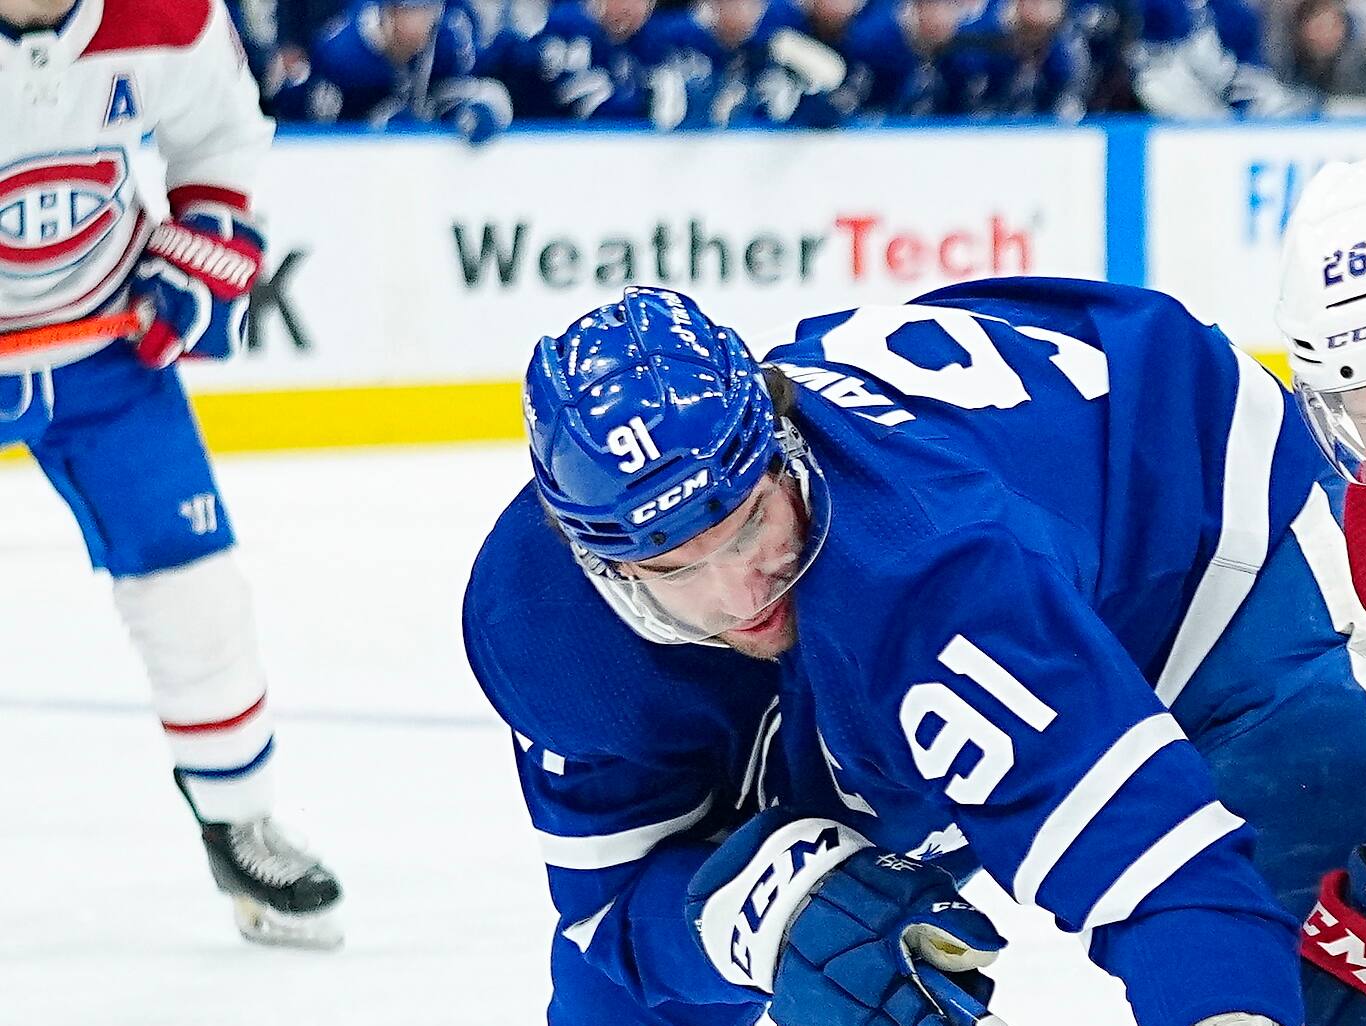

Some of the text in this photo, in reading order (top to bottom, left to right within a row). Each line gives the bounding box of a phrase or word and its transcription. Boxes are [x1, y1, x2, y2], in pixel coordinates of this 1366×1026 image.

[103, 72, 143, 129] A
[450, 210, 1034, 290] WeatherTech
[607, 415, 661, 474] 91
[630, 467, 709, 525] CCM
[898, 634, 1058, 806] 91
[730, 825, 841, 981] CCM
[931, 901, 977, 914] CC
